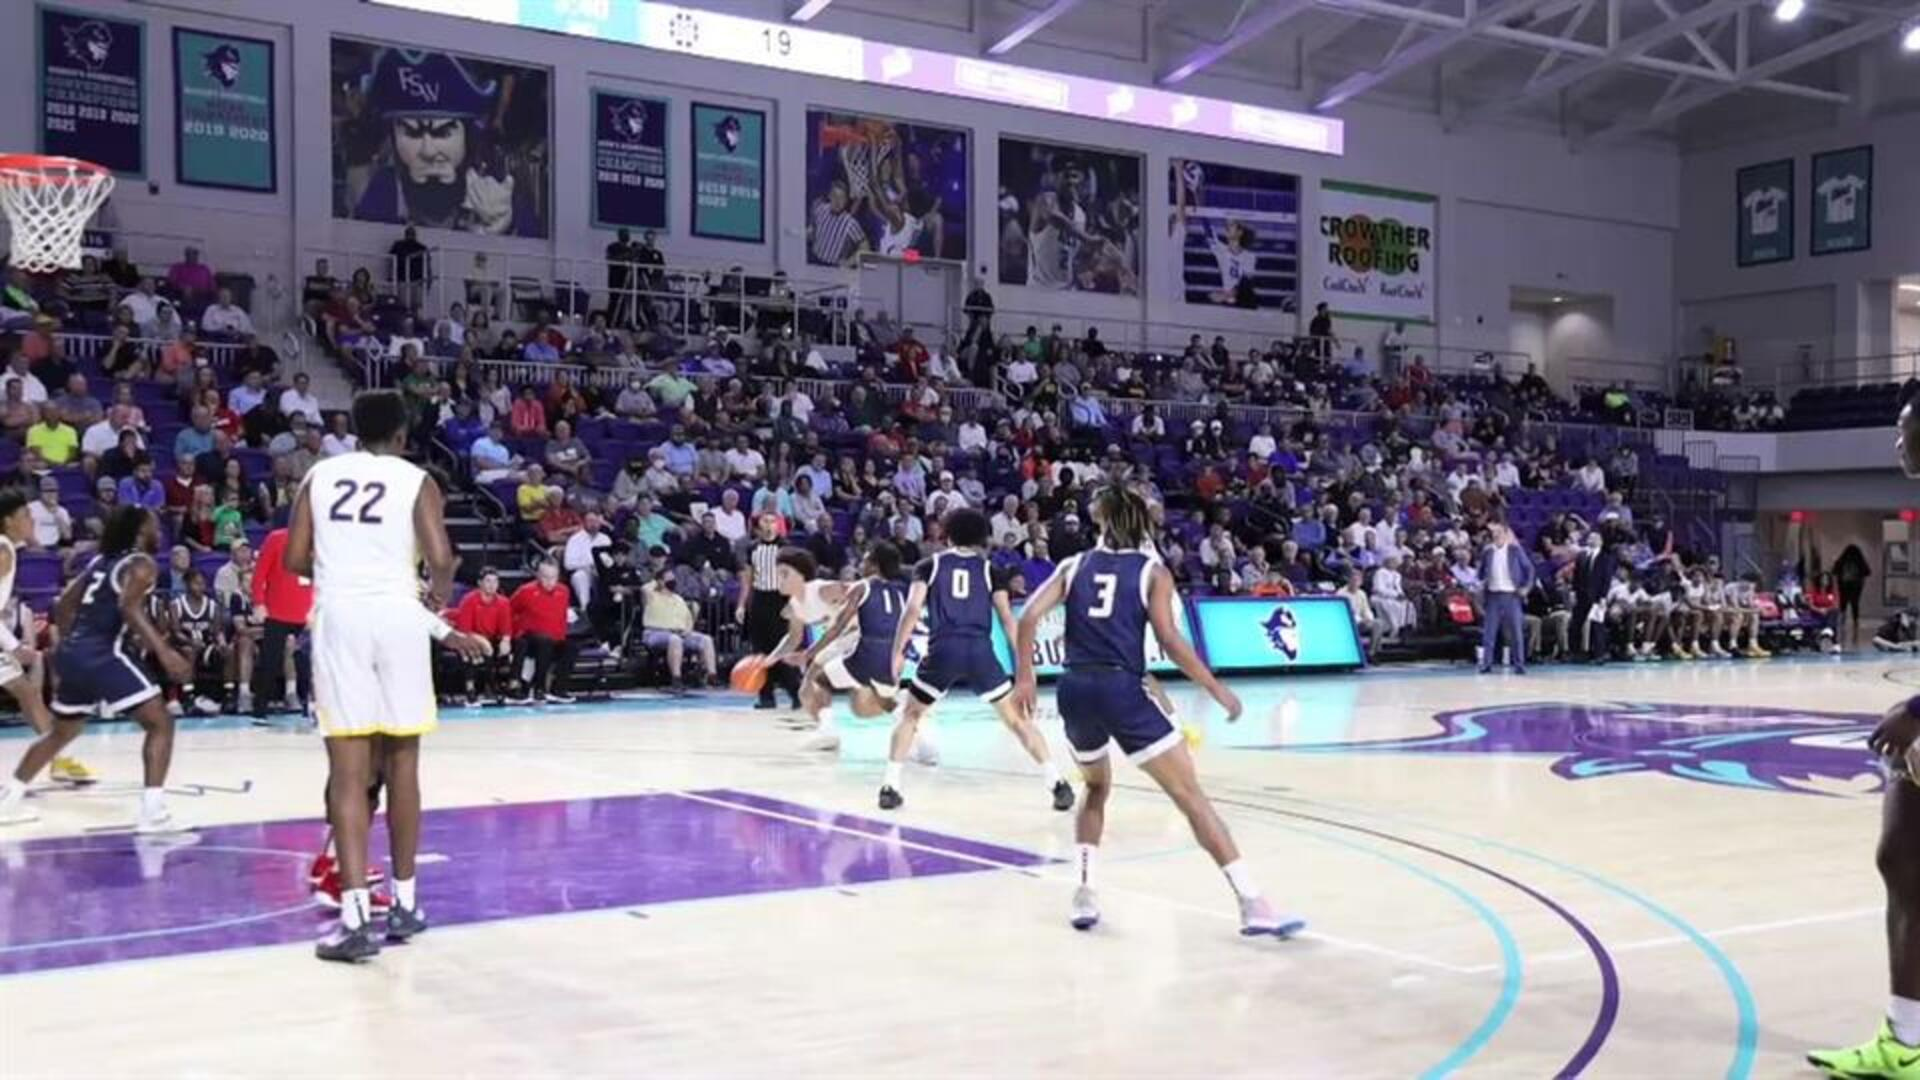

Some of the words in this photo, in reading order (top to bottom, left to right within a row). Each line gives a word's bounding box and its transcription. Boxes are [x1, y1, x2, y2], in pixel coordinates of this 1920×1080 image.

[761, 27, 792, 55] 19
[398, 67, 440, 103] FSW
[1320, 215, 1430, 251] CROWTHER
[1329, 242, 1420, 273] ROOFING
[329, 478, 386, 524] 22
[81, 570, 107, 605] 2
[951, 568, 969, 599] 0
[1087, 573, 1118, 618] 3
